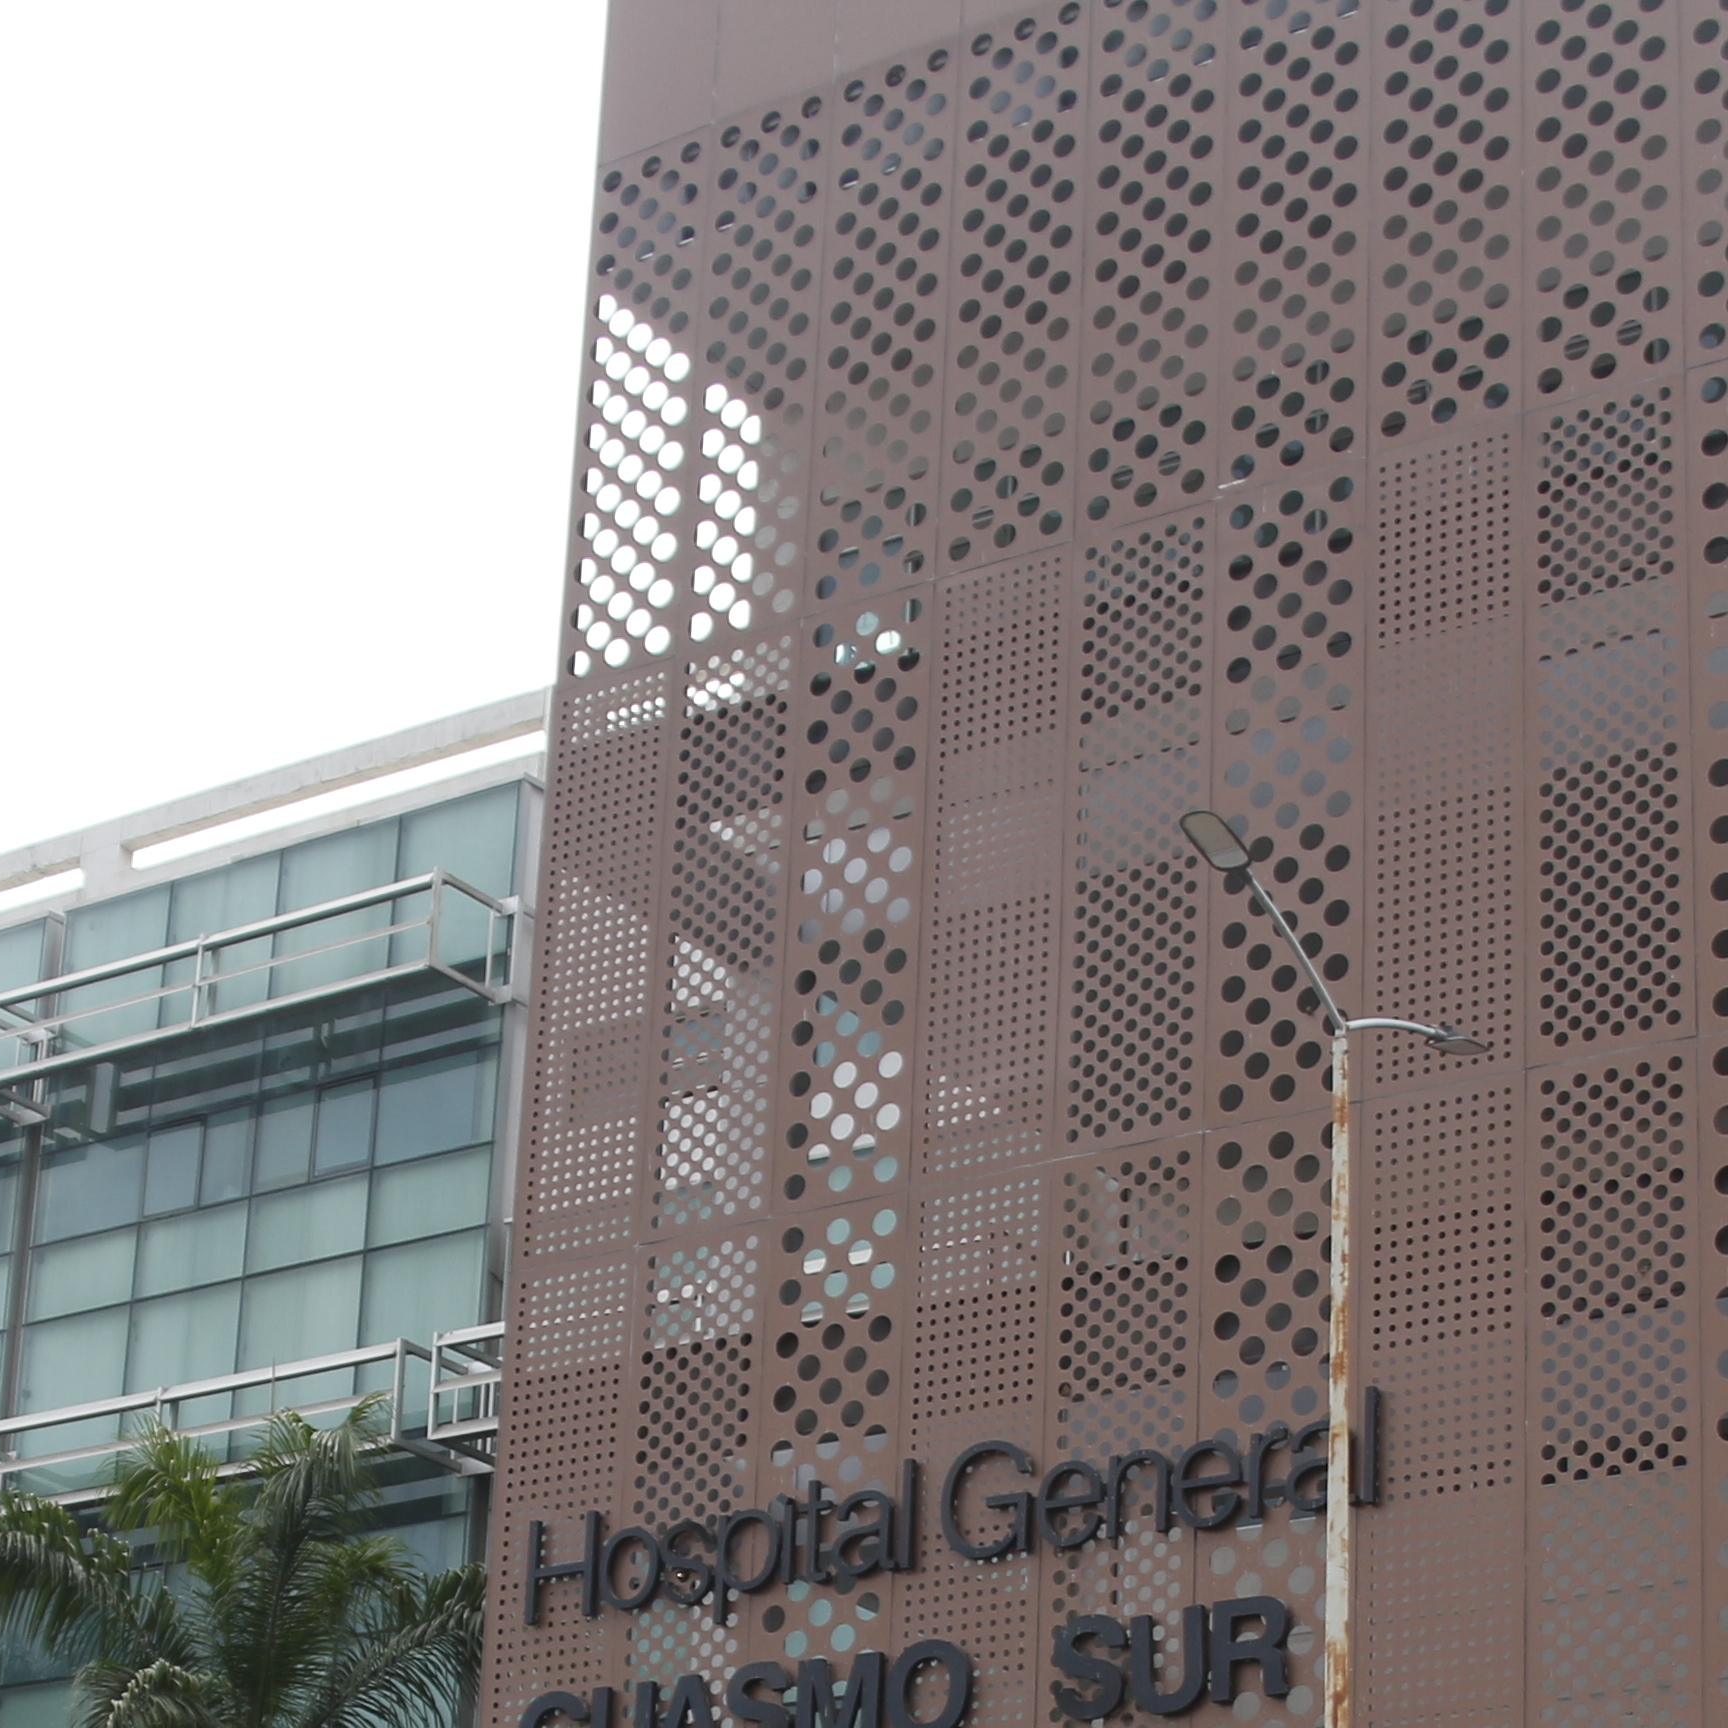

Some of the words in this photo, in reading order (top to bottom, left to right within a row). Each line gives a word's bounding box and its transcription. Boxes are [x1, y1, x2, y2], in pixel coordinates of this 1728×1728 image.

[524, 1456, 919, 1627] Hospital
[940, 1385, 1382, 1562] General
[1058, 1594, 1290, 1721] SUR
